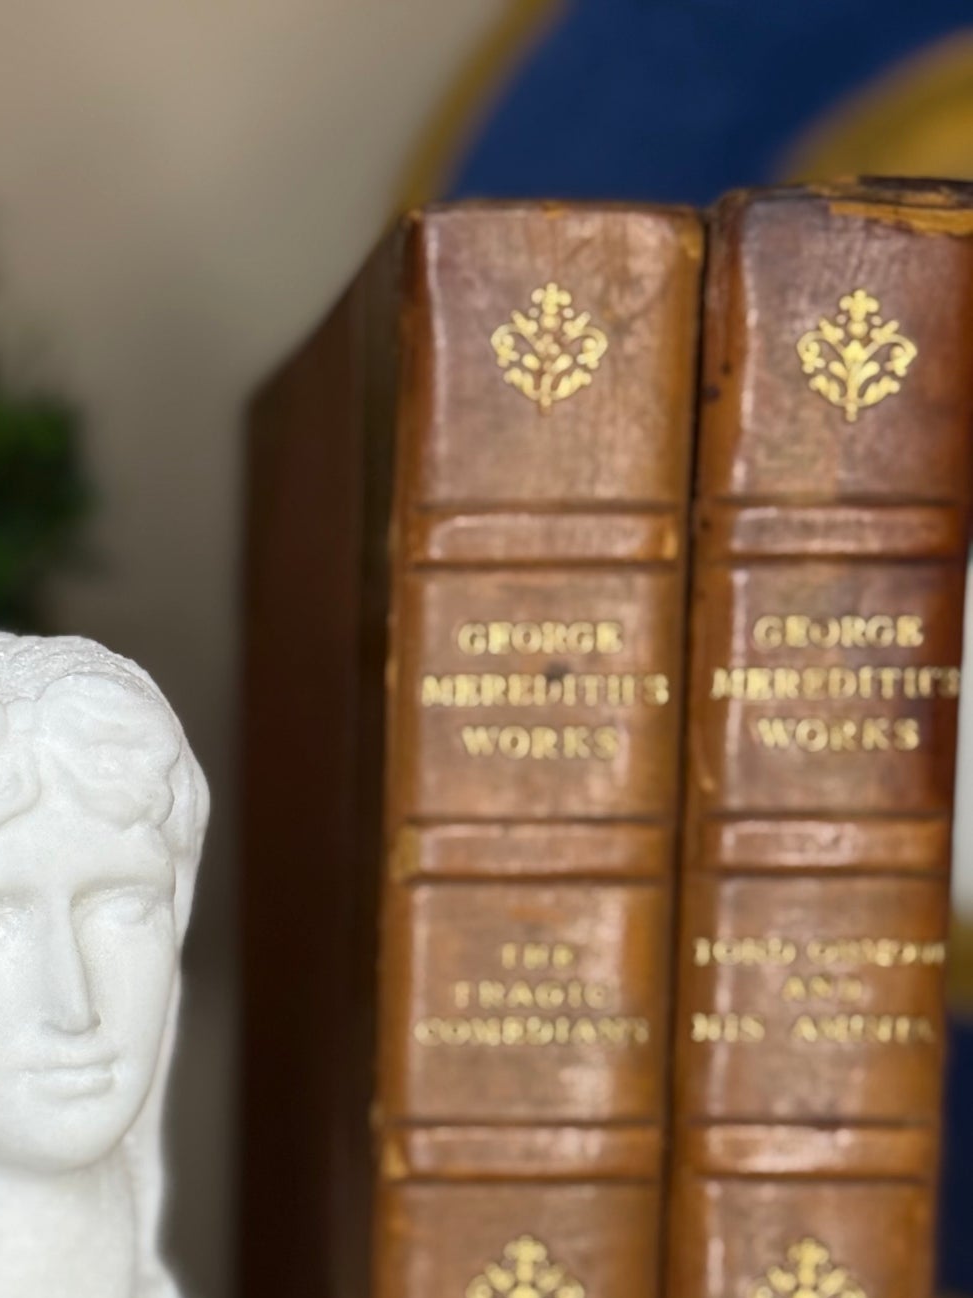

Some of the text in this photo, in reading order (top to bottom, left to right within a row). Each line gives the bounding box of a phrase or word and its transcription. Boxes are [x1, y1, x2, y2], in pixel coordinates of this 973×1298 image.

[458, 621, 624, 655] GEORGE
[753, 615, 924, 648] GEORGE
[462, 725, 620, 760] WORKS
[758, 717, 919, 752] WORKS
